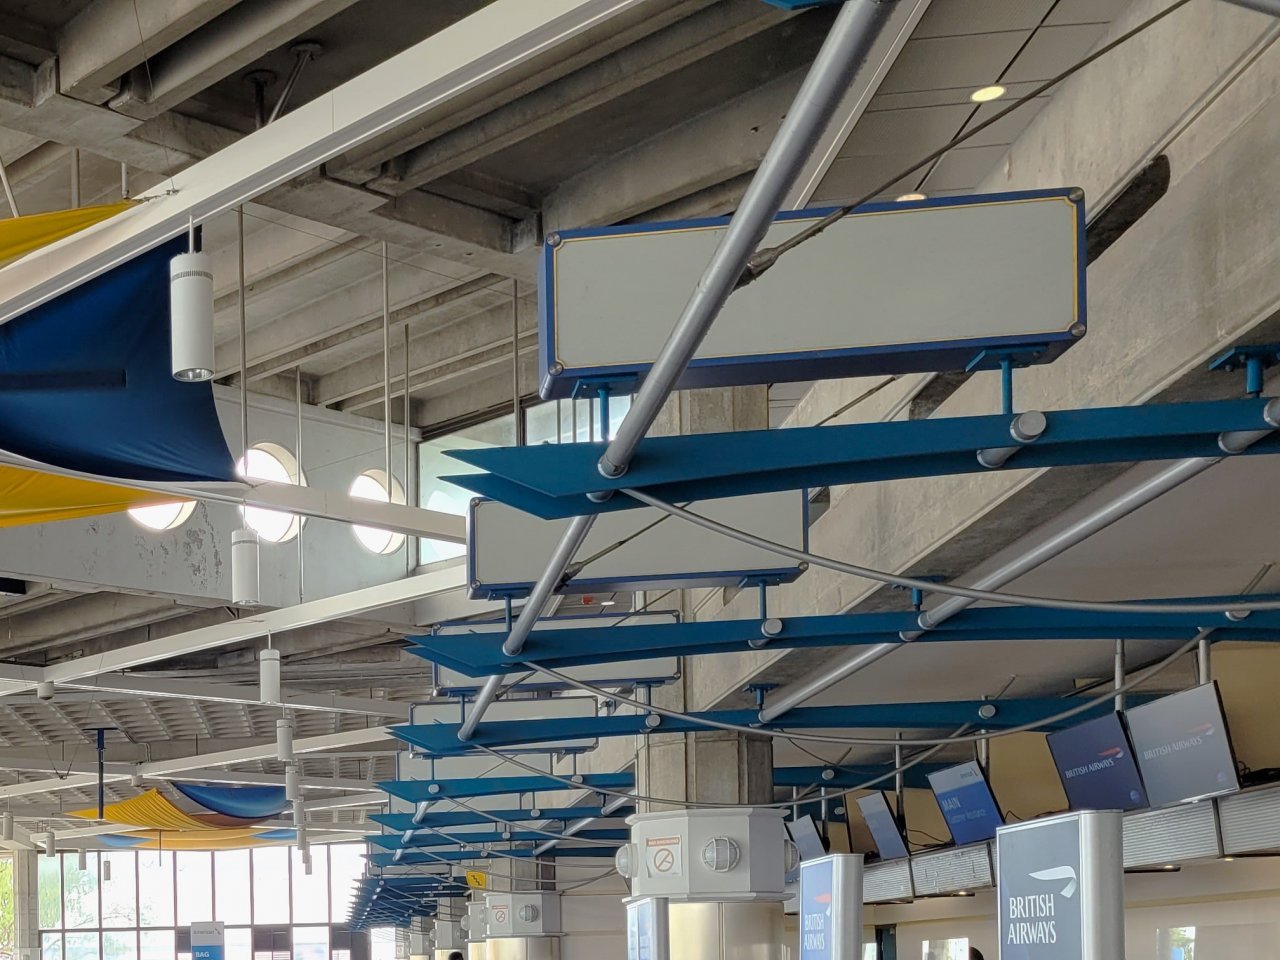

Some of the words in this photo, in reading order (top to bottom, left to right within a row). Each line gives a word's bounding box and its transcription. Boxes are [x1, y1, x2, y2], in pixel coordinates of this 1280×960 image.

[1144, 745, 1171, 760] BRITISH
[1172, 736, 1202, 751] AIRWAYS
[1065, 766, 1088, 778] BRITISH
[1088, 758, 1114, 772] AIRWAYS
[1009, 894, 1055, 919] BRITISH
[805, 913, 824, 931] BRITISH
[1008, 921, 1056, 944] AIRWAYS
[804, 933, 824, 950] AIRWAYS
